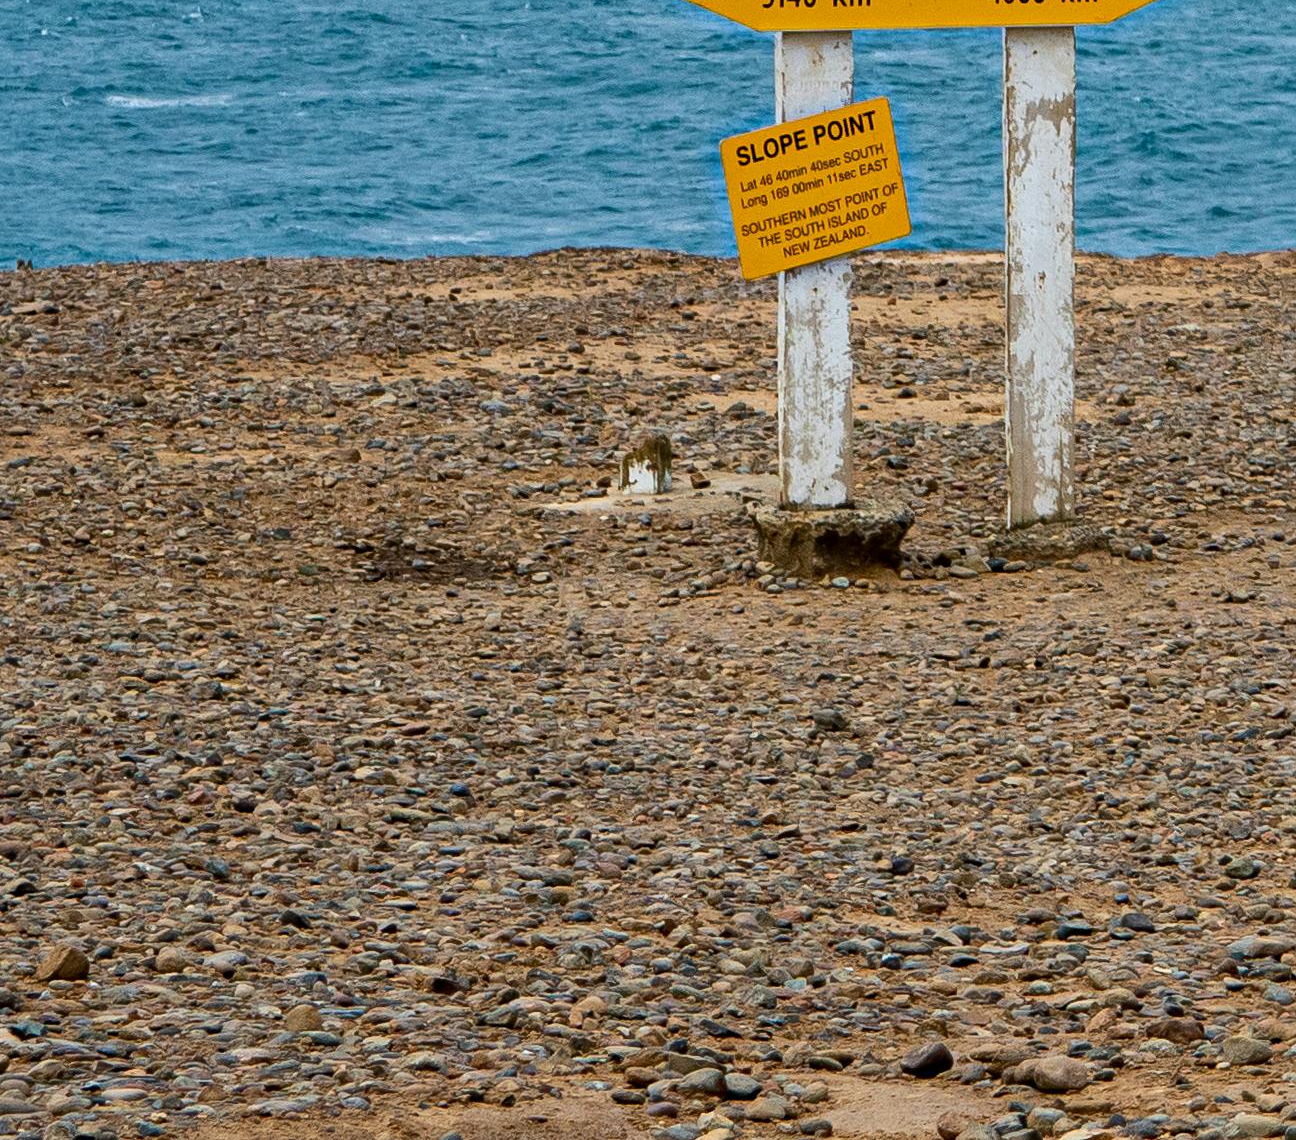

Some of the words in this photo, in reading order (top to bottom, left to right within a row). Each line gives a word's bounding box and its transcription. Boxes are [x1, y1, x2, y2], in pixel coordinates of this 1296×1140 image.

[736, 130, 808, 166] SLOPE
[813, 111, 875, 145] POINT
[740, 179, 757, 192] Lat
[760, 174, 773, 186] 46
[776, 166, 807, 181] 40min
[810, 157, 841, 172] 40sec
[844, 143, 884, 164] SOUTH
[741, 194, 768, 209] Long
[771, 186, 789, 200] 169
[792, 179, 824, 195] 00min
[827, 169, 856, 185] 11sec
[859, 158, 888, 176] EAST
[741, 207, 806, 237] SOUTHERN
[809, 199, 846, 217] MOST
[845, 188, 881, 207] POINT
[883, 183, 898, 196] OF
[759, 232, 781, 248] THE
[785, 219, 825, 241] SOUTH
[828, 208, 869, 228] ISLAND
[872, 203, 887, 216] OF
[783, 240, 810, 258] NEW
[814, 225, 869, 250] ZEALAND.
